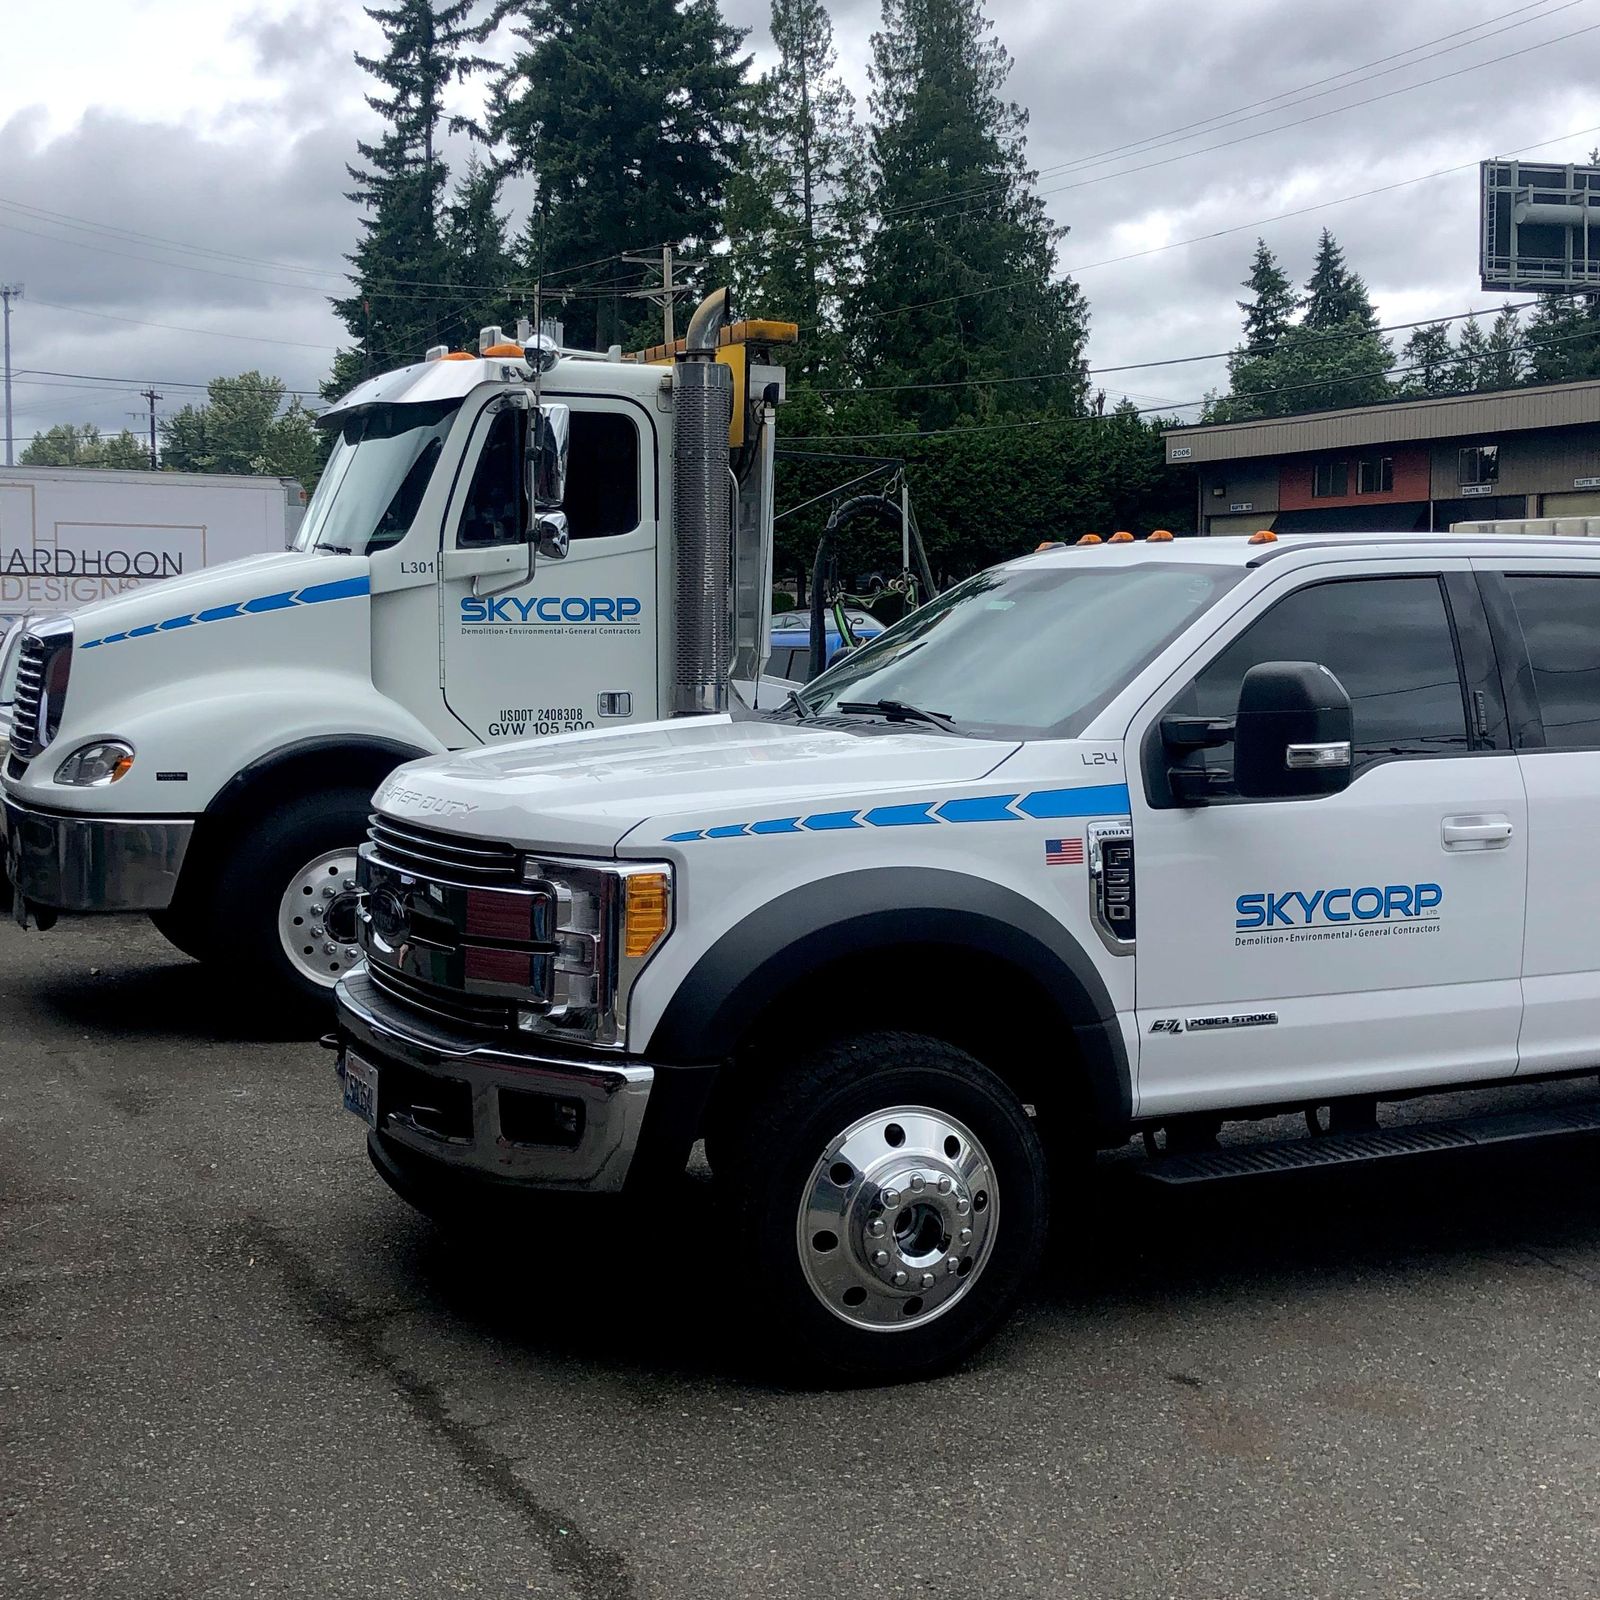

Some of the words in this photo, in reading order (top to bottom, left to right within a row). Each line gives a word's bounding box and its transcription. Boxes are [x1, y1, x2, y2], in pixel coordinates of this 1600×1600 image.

[1173, 449, 1190, 457] 2006
[0, 547, 183, 576] ARDHOON
[400, 561, 434, 574] L301
[461, 597, 642, 622] SKYCORP
[461, 627, 504, 635] Demolition
[509, 627, 564, 635] Environmental
[568, 627, 597, 635] General
[599, 627, 641, 635] Contractors
[500, 709, 534, 722] USDOT
[538, 708, 583, 721] 2408308
[488, 722, 526, 736] GVW
[1081, 751, 1119, 766] L24
[1096, 829, 1131, 837] LARIAT
[1235, 883, 1443, 929] SKYCORP
[1234, 934, 1284, 947] Demolition
[1289, 929, 1353, 943] Environmental
[1358, 926, 1391, 938] General
[1392, 924, 1441, 935] Contractors
[1190, 1016, 1229, 1027] POWER
[1231, 1012, 1276, 1024] STROKE
